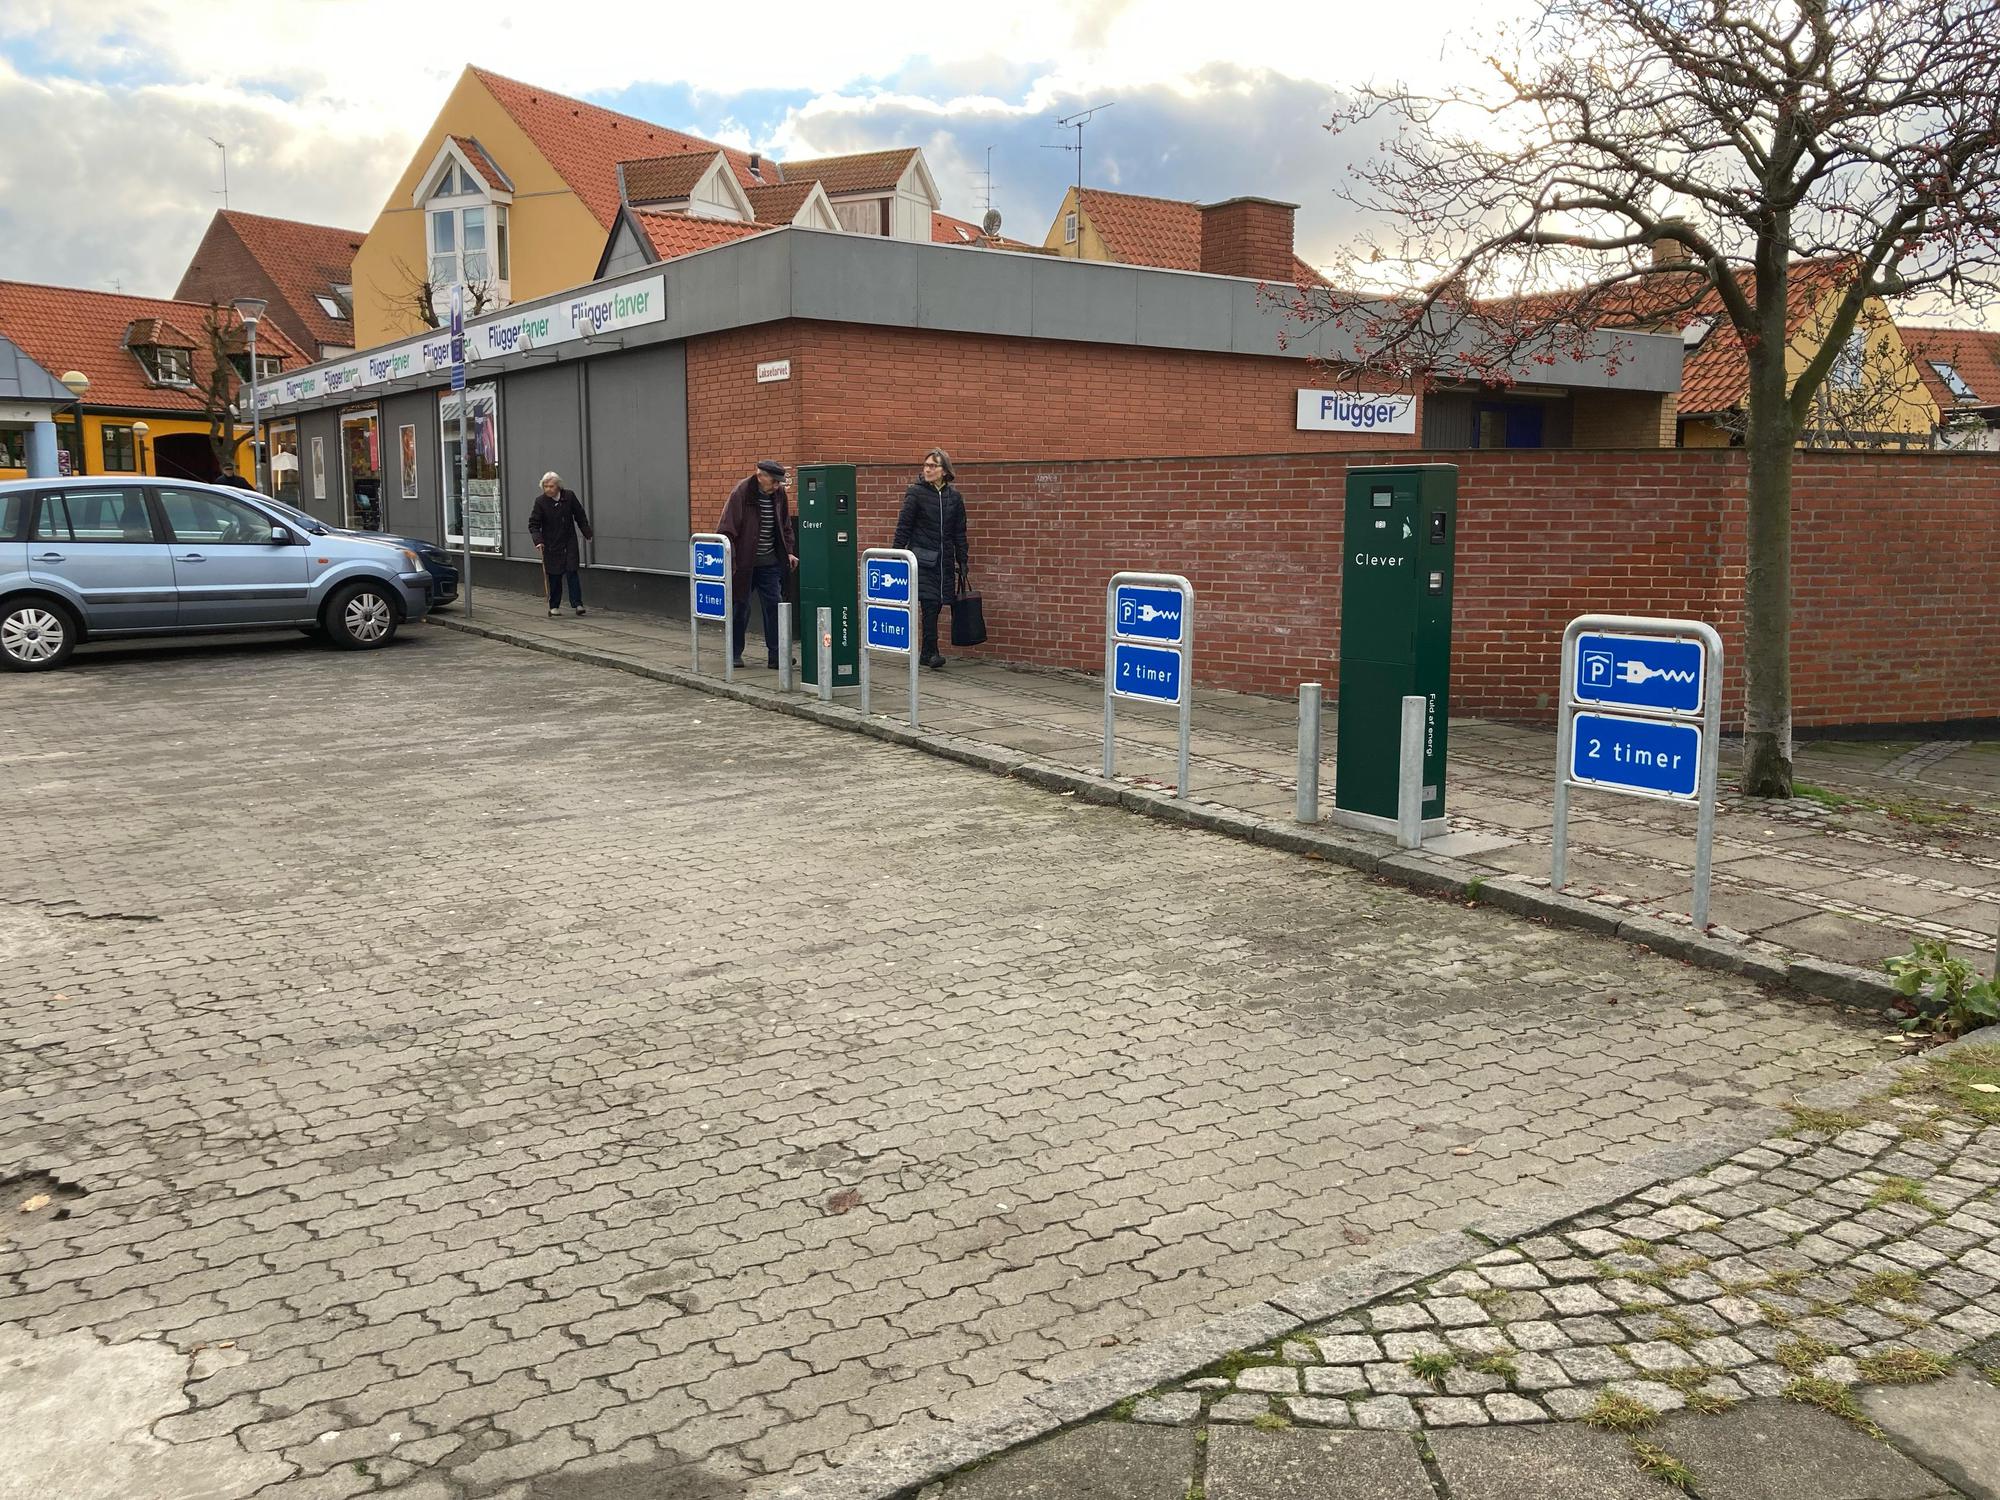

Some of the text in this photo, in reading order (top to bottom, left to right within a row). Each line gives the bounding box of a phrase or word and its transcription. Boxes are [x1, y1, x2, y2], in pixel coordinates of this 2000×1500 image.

[613, 292, 650, 319] farver
[1320, 395, 1397, 429] Flügger
[802, 519, 823, 530] Clever
[1355, 552, 1405, 567] Clever
[699, 593, 723, 606] 2 timer
[872, 620, 905, 636] 2 timer
[1123, 662, 1172, 683] 2 timer
[1425, 693, 1436, 757] Fuld af energi
[1588, 738, 1682, 770] 2 timer
